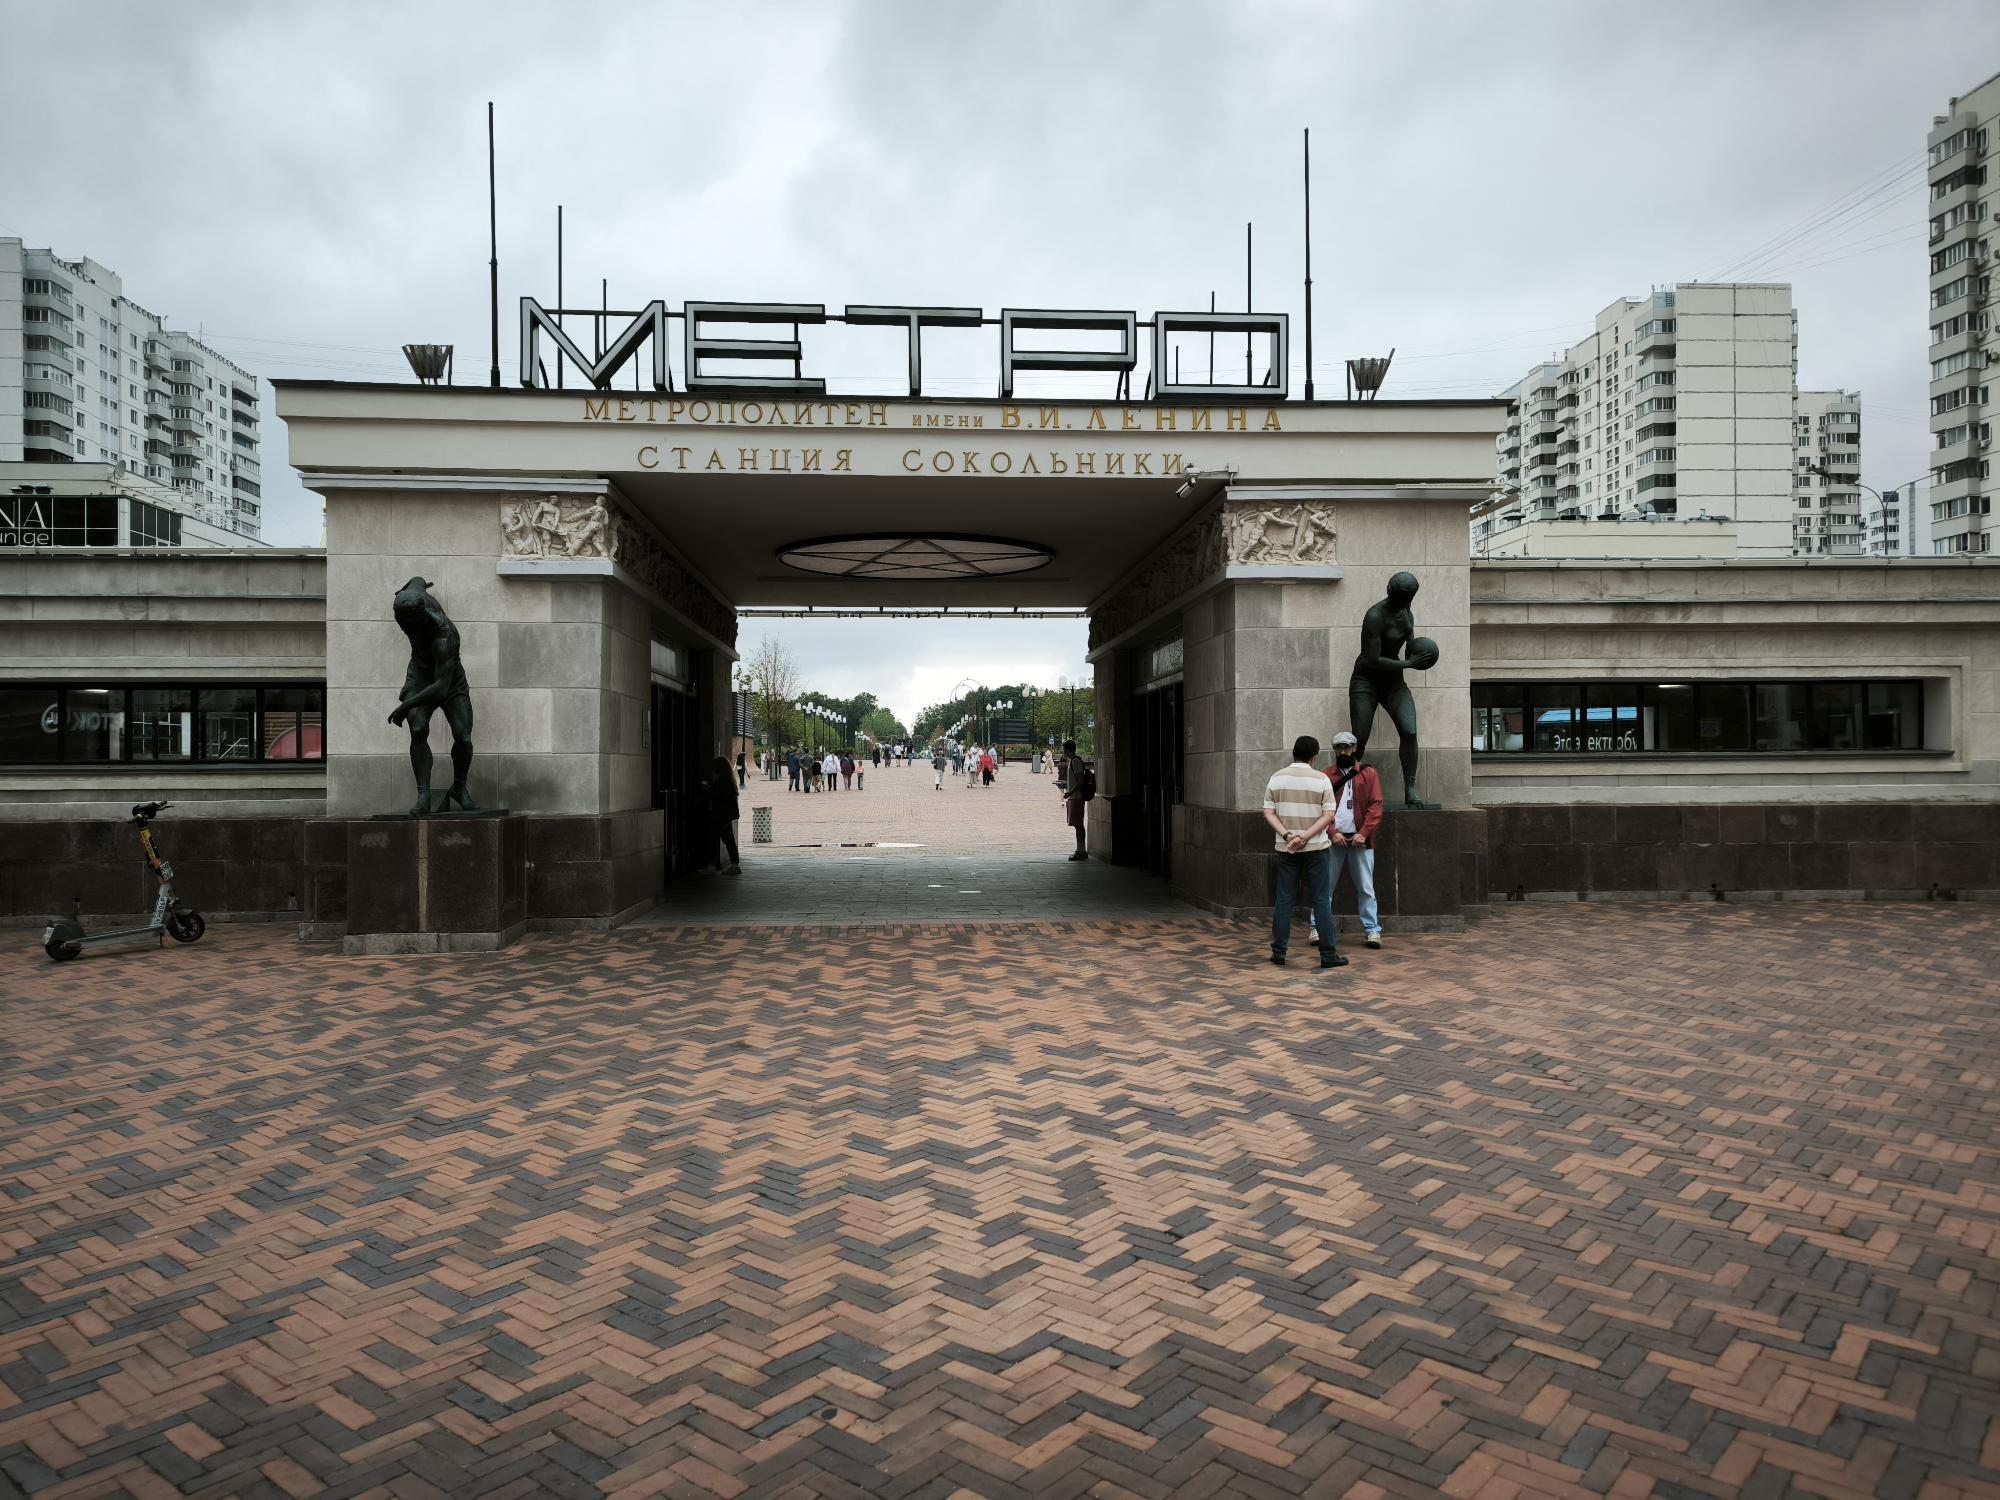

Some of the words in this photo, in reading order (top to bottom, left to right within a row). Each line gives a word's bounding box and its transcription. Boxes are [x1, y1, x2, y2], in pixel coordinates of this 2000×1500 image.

[520, 296, 1289, 400] МЕТРО
[583, 398, 889, 426] МЕТРОПОЛИТЕН
[912, 413, 984, 428] ИМЕНИ
[637, 446, 853, 473] СТАНЦИЯ
[902, 448, 1184, 475] СОКОЛЬНИКИ
